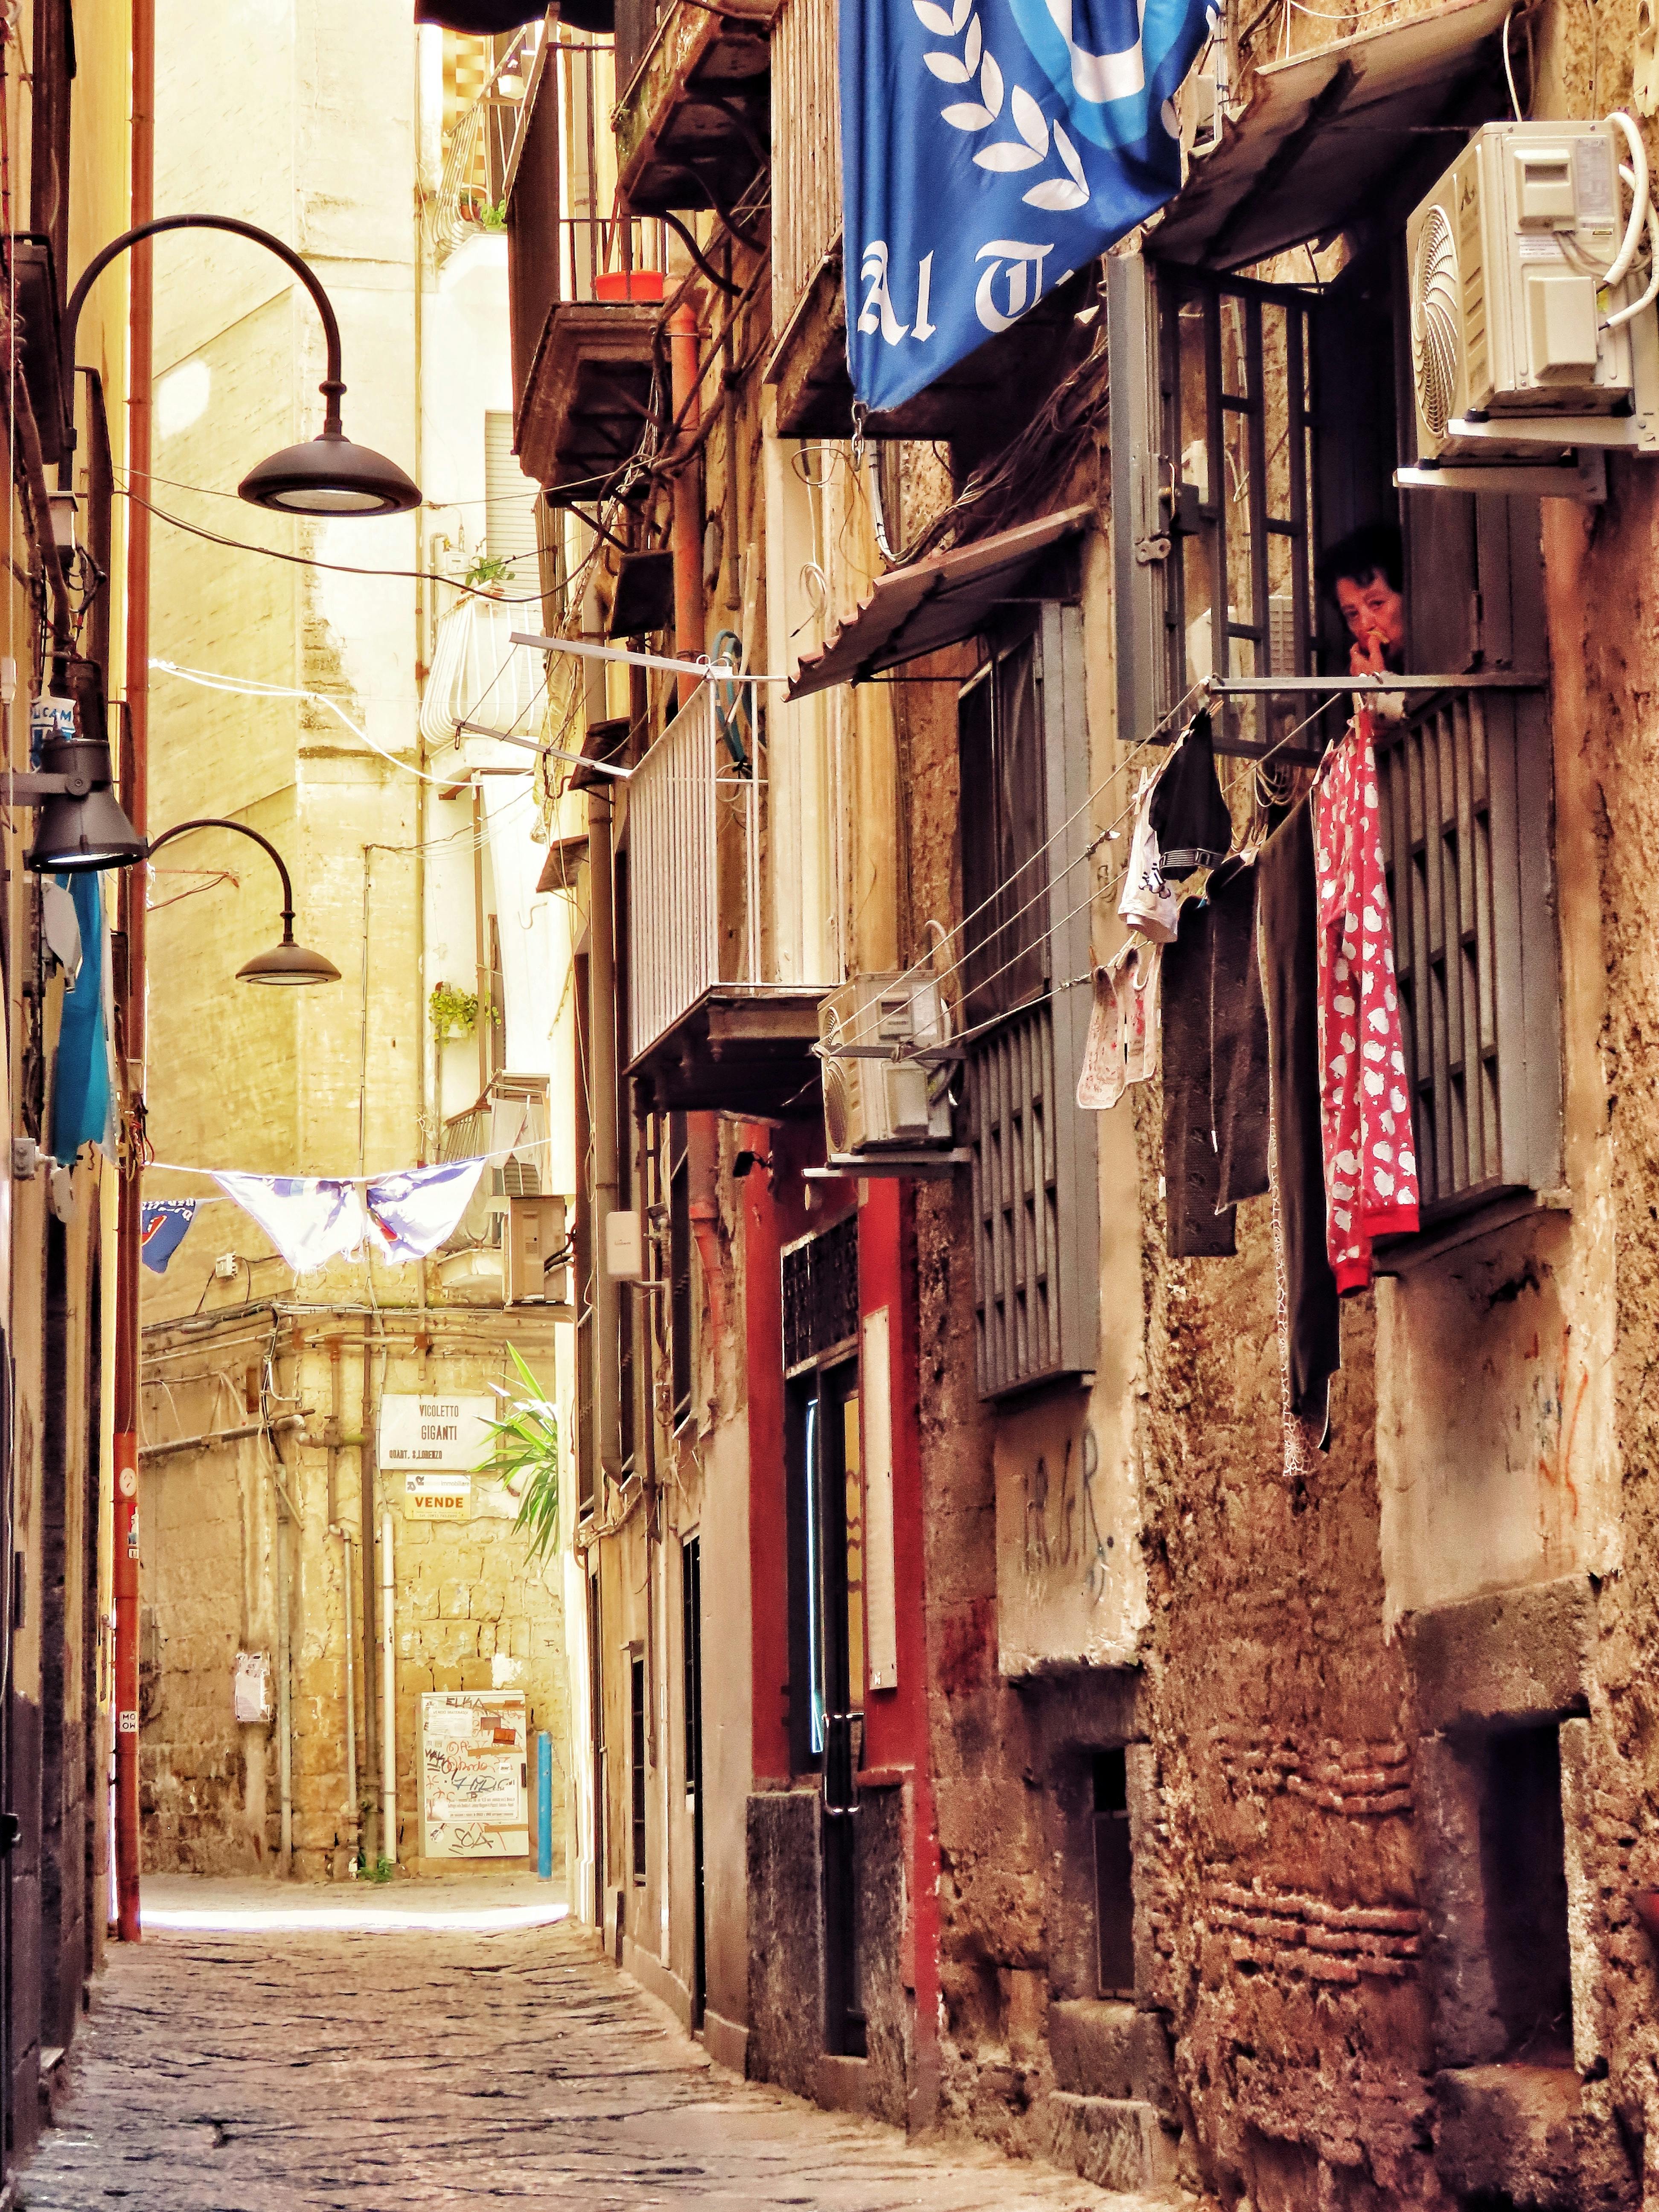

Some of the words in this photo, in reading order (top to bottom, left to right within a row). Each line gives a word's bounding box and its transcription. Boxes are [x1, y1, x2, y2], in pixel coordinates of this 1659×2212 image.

[419, 1405, 459, 1417] VICOLETTO
[421, 1426, 457, 1440] GIGANTI
[415, 1497, 464, 1508] VENDE
